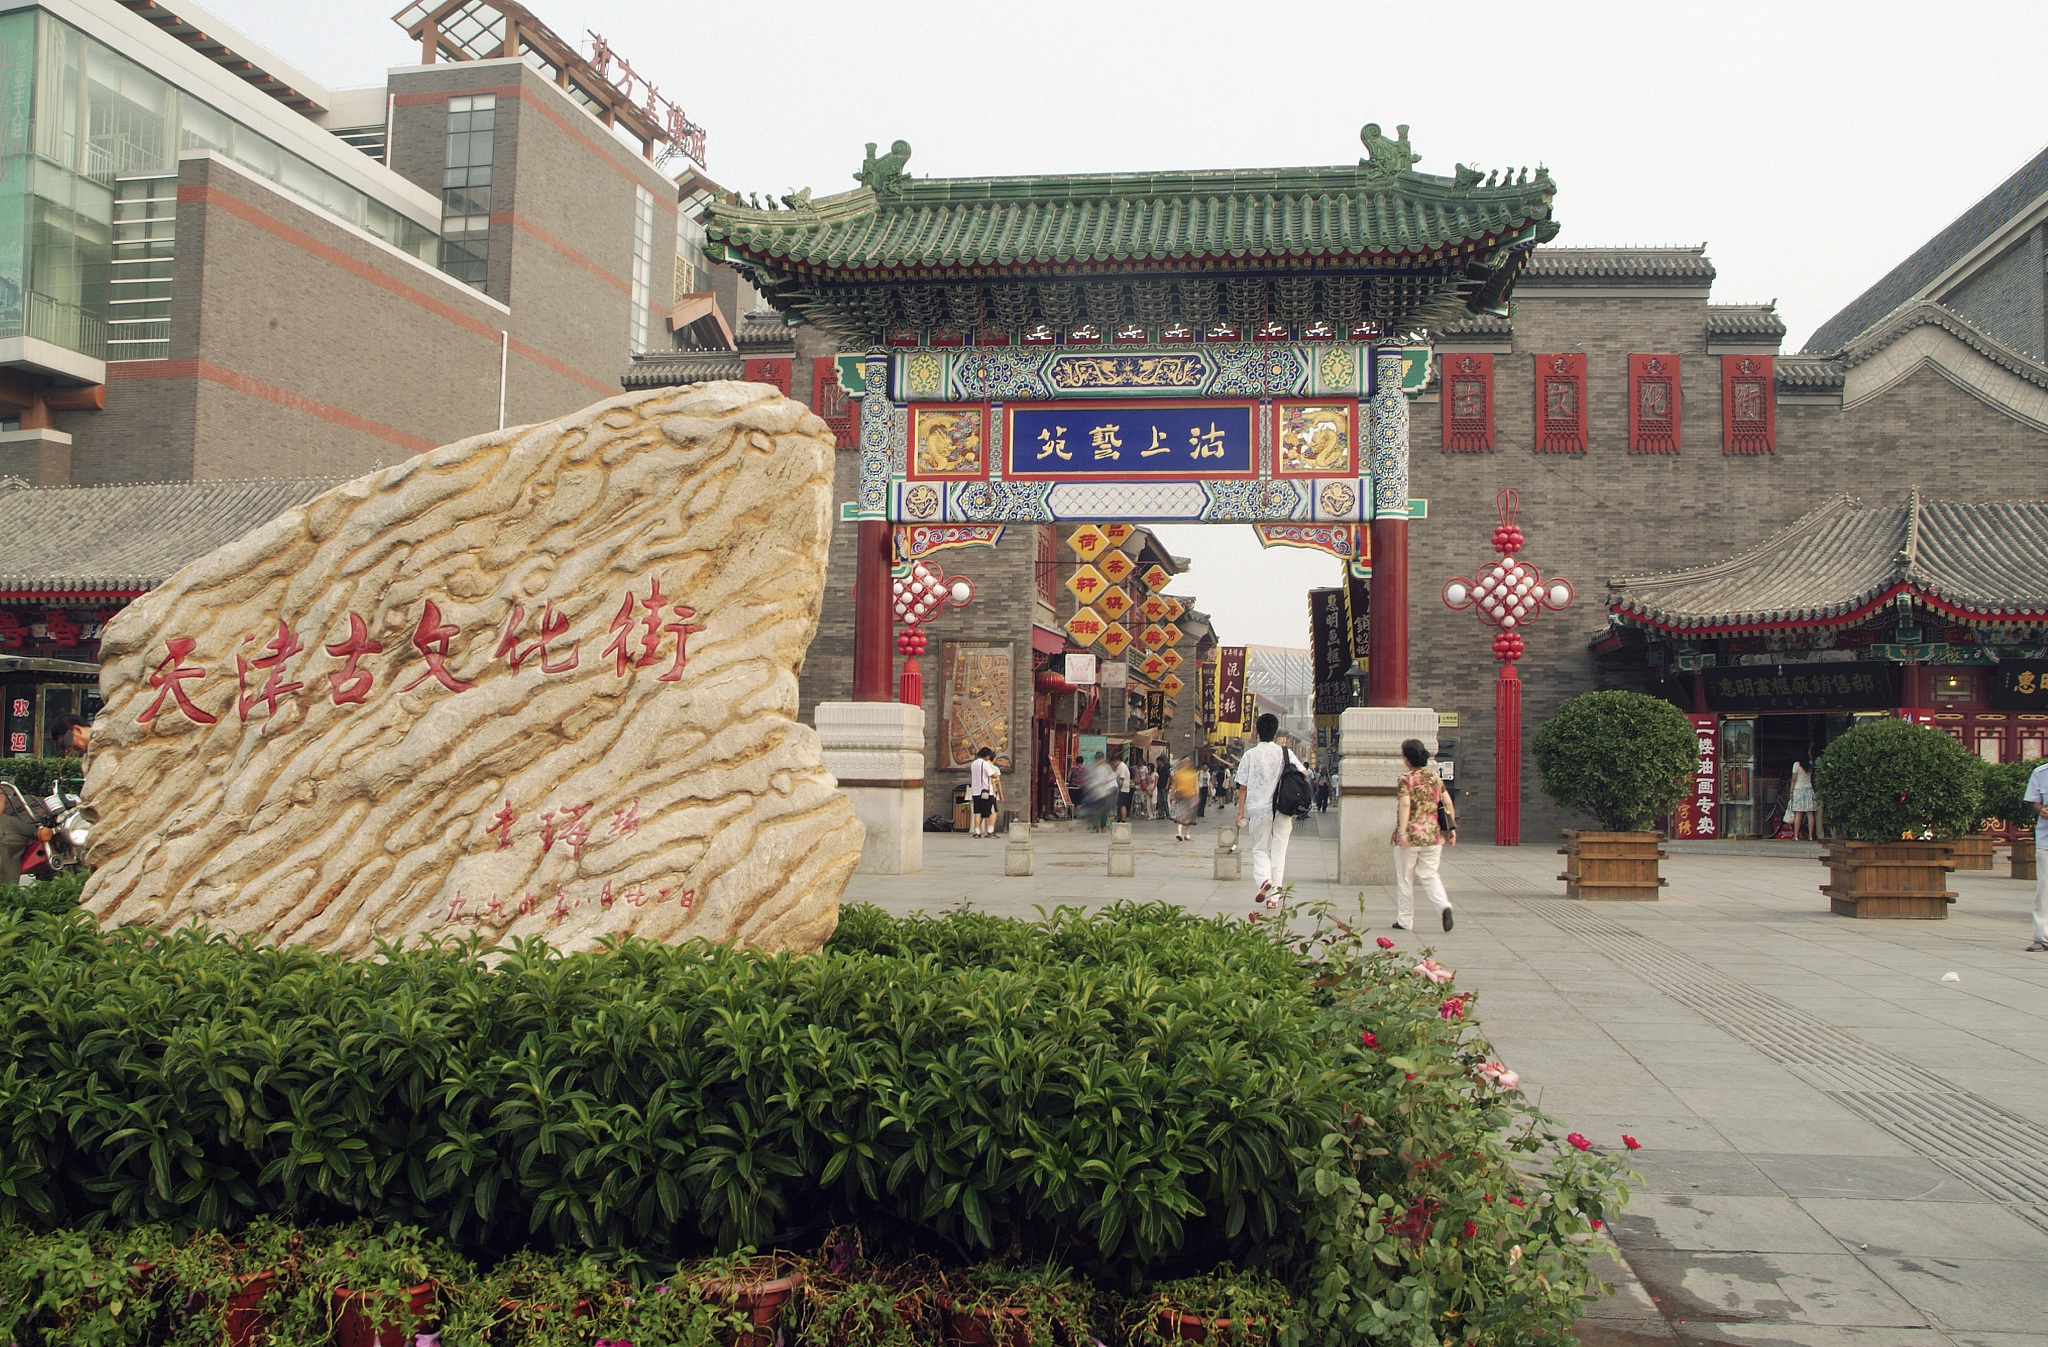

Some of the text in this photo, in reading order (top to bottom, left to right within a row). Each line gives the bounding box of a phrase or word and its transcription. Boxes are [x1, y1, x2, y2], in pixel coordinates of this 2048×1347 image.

[136, 576, 707, 735] 天津古文化街
[1325, 593, 1341, 680] 惠明画框厂
[11, 698, 29, 751] 欢迎
[1678, 803, 1692, 836] 字绣
[1696, 720, 1715, 835] 二楼油画专卖
